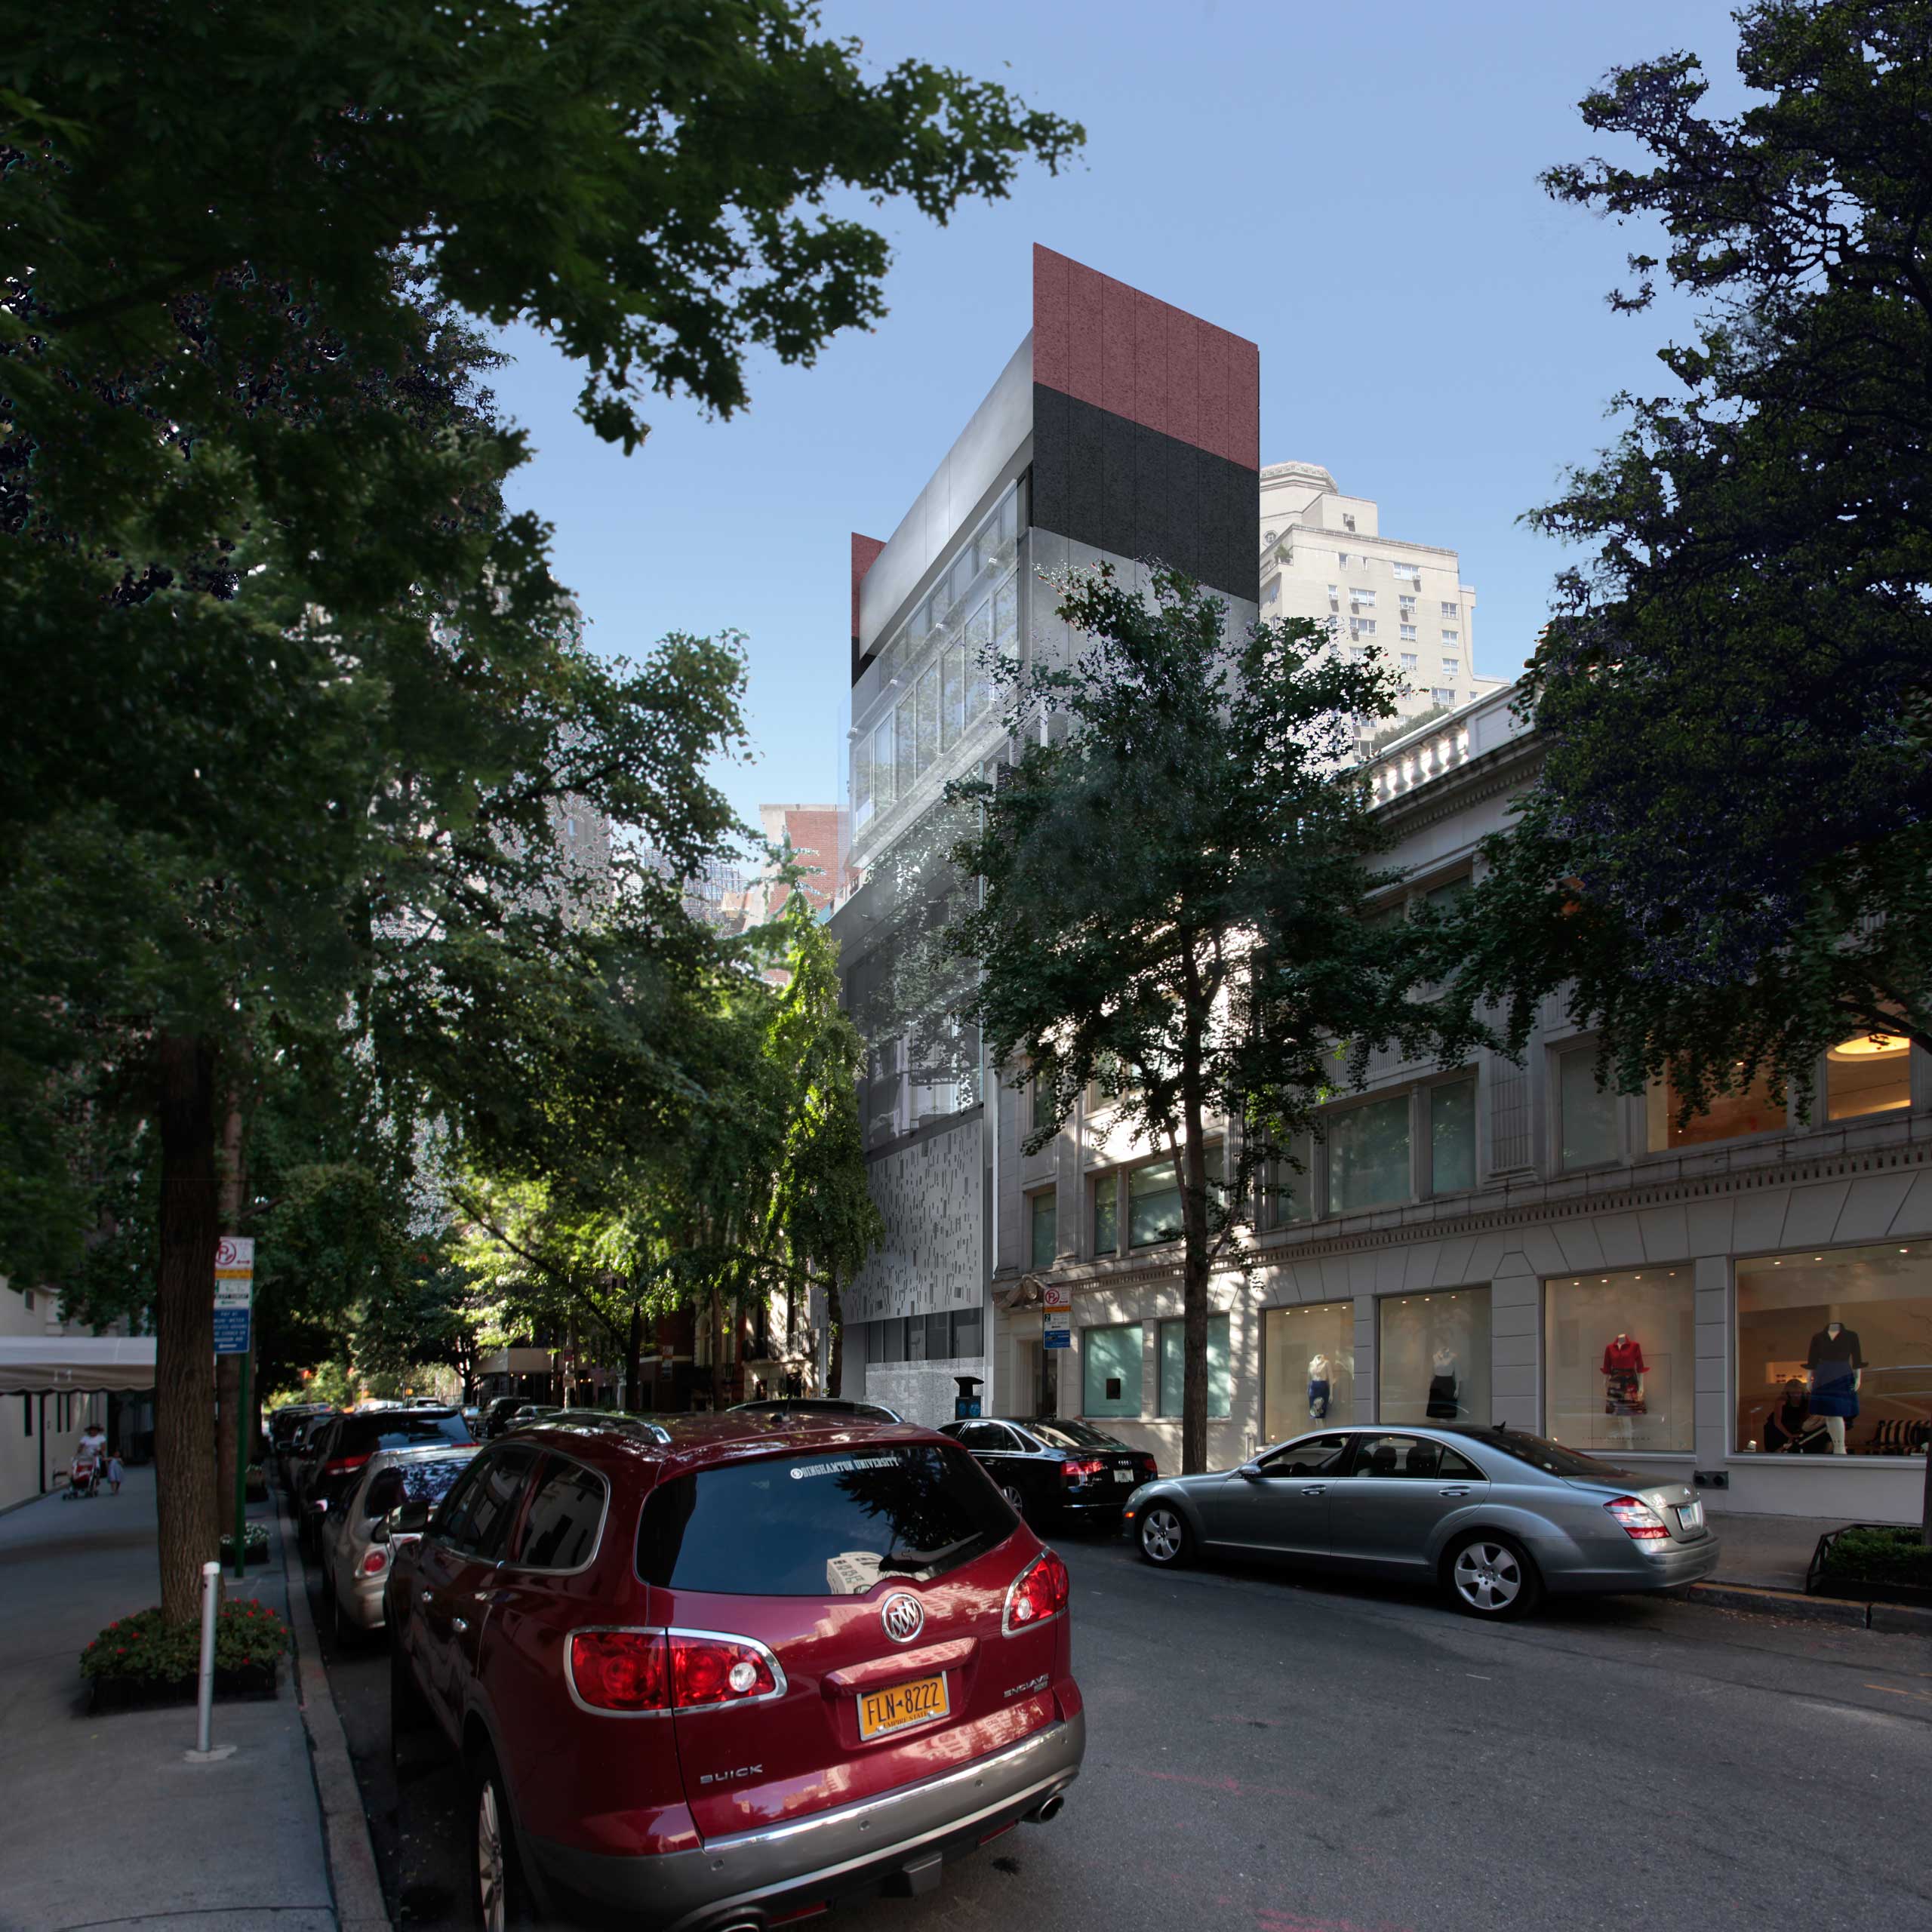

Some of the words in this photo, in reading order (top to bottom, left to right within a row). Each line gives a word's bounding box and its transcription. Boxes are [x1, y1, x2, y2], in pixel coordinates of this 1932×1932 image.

[802, 1460, 853, 1478] BINGHAMTON
[855, 1457, 900, 1469] UNIVERSITY
[1003, 1673, 1049, 1698] ENCLAVE
[700, 1764, 763, 1784] BUICK
